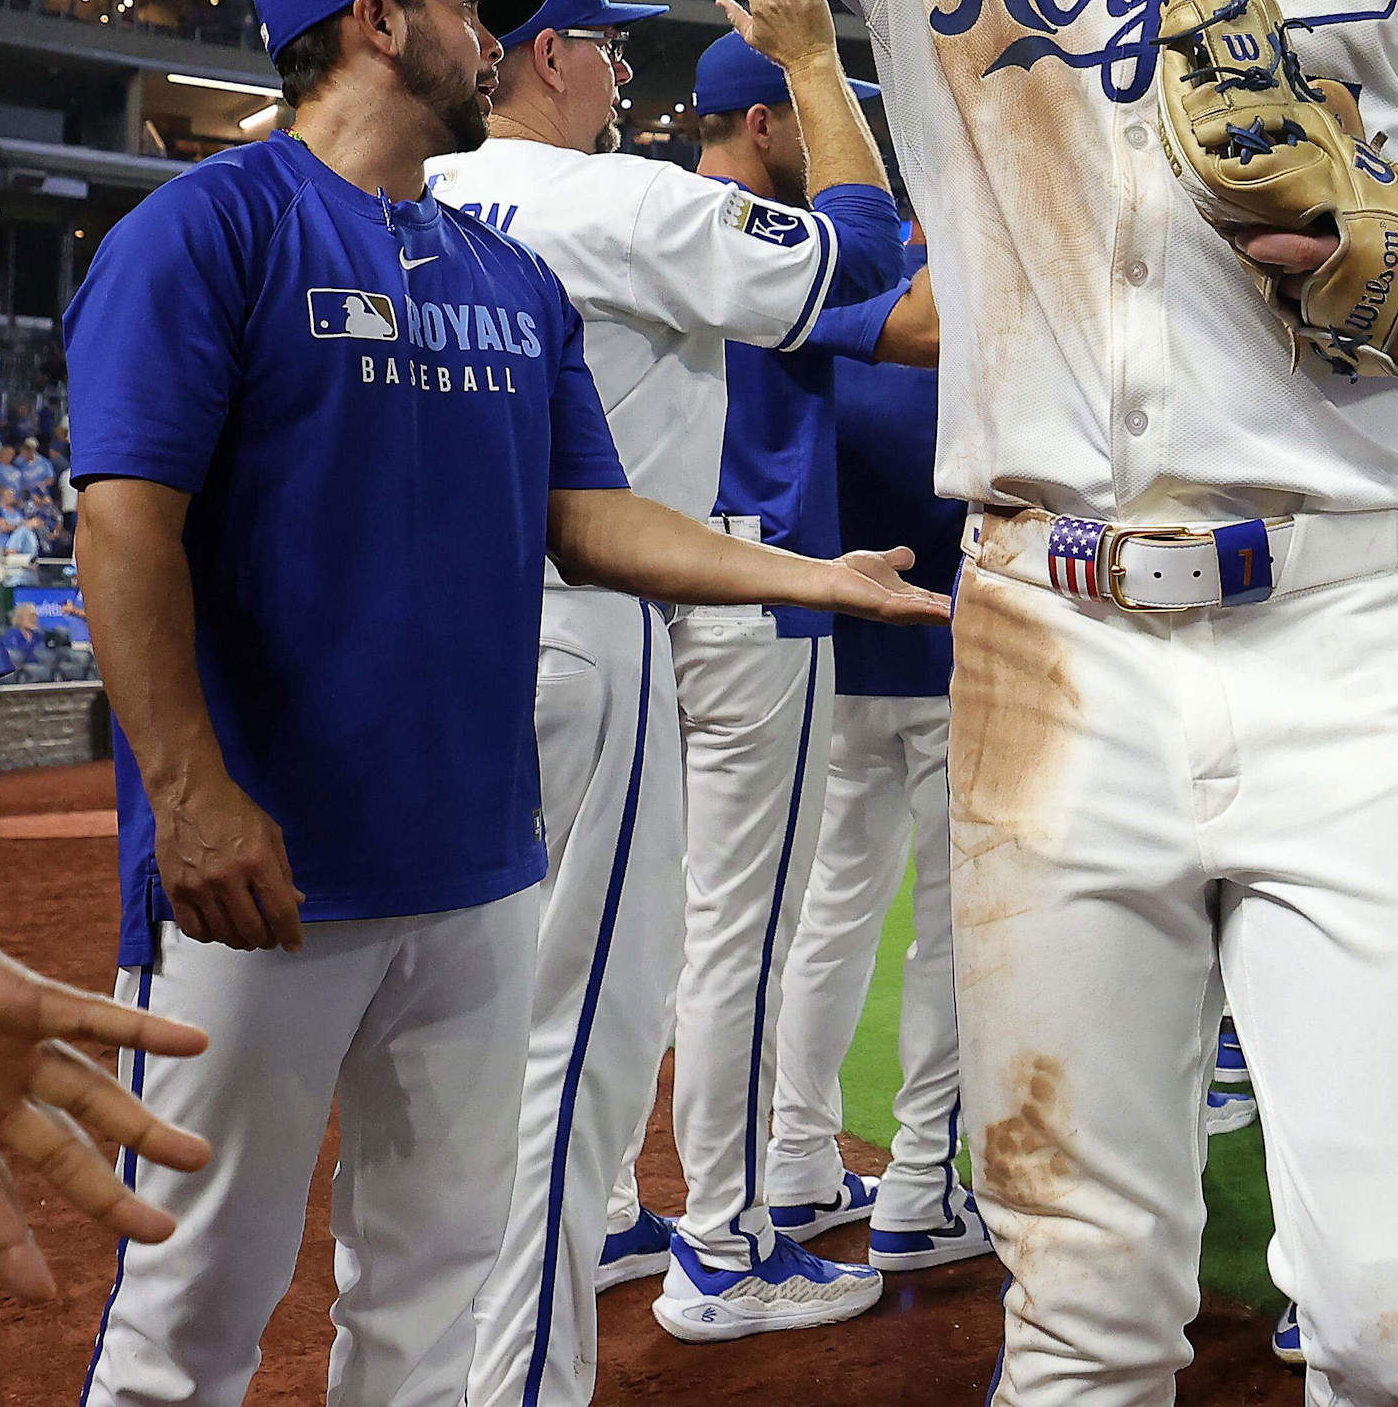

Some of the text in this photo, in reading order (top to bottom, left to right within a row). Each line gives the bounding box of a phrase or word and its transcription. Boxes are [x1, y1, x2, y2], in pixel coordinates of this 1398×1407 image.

[751, 209, 799, 244] KC
[1345, 229, 1398, 333] Wilson
[404, 294, 542, 358] ROYALS
[361, 356, 516, 393] BASEBALL
[1237, 548, 1253, 586] 7
